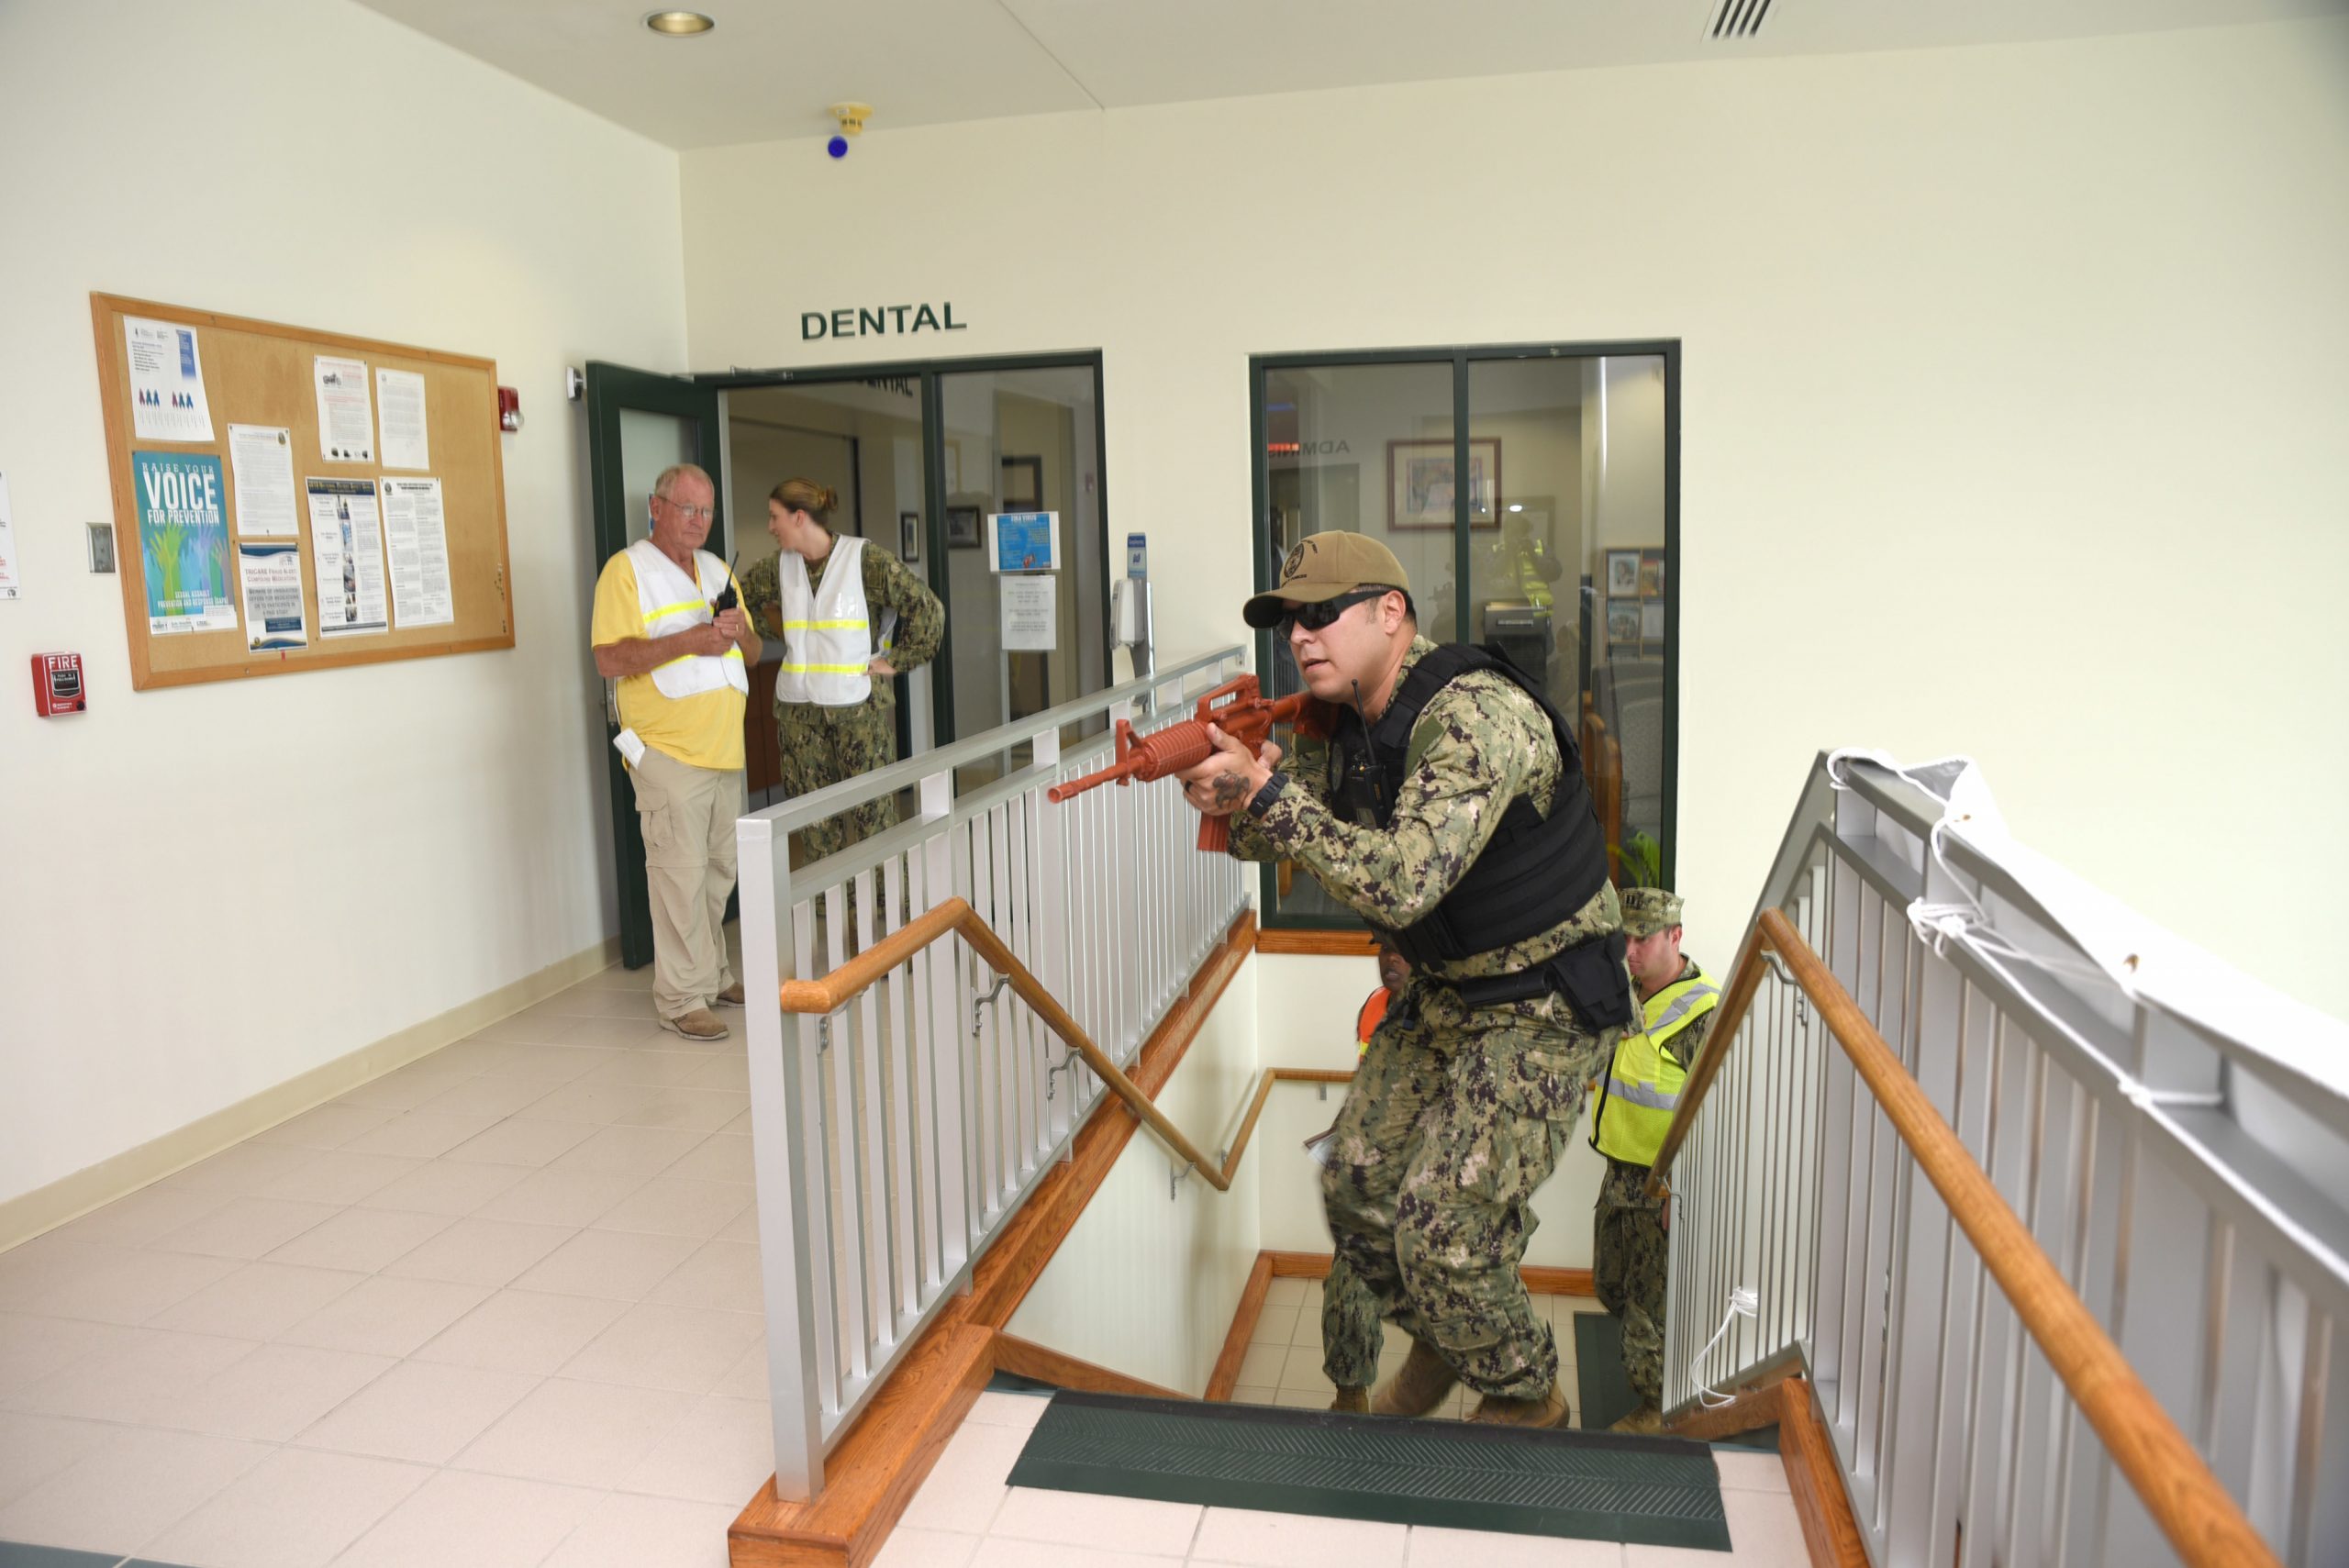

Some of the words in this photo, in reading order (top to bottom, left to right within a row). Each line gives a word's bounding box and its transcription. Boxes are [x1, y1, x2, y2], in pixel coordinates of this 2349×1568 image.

[801, 301, 967, 340] DENTAL
[141, 462, 179, 473] RAISE
[184, 463, 214, 474] YOUR
[142, 471, 219, 510] VOICE
[147, 508, 165, 526] FOR
[167, 508, 220, 527] PREVENTION
[48, 655, 79, 670] FIRE
